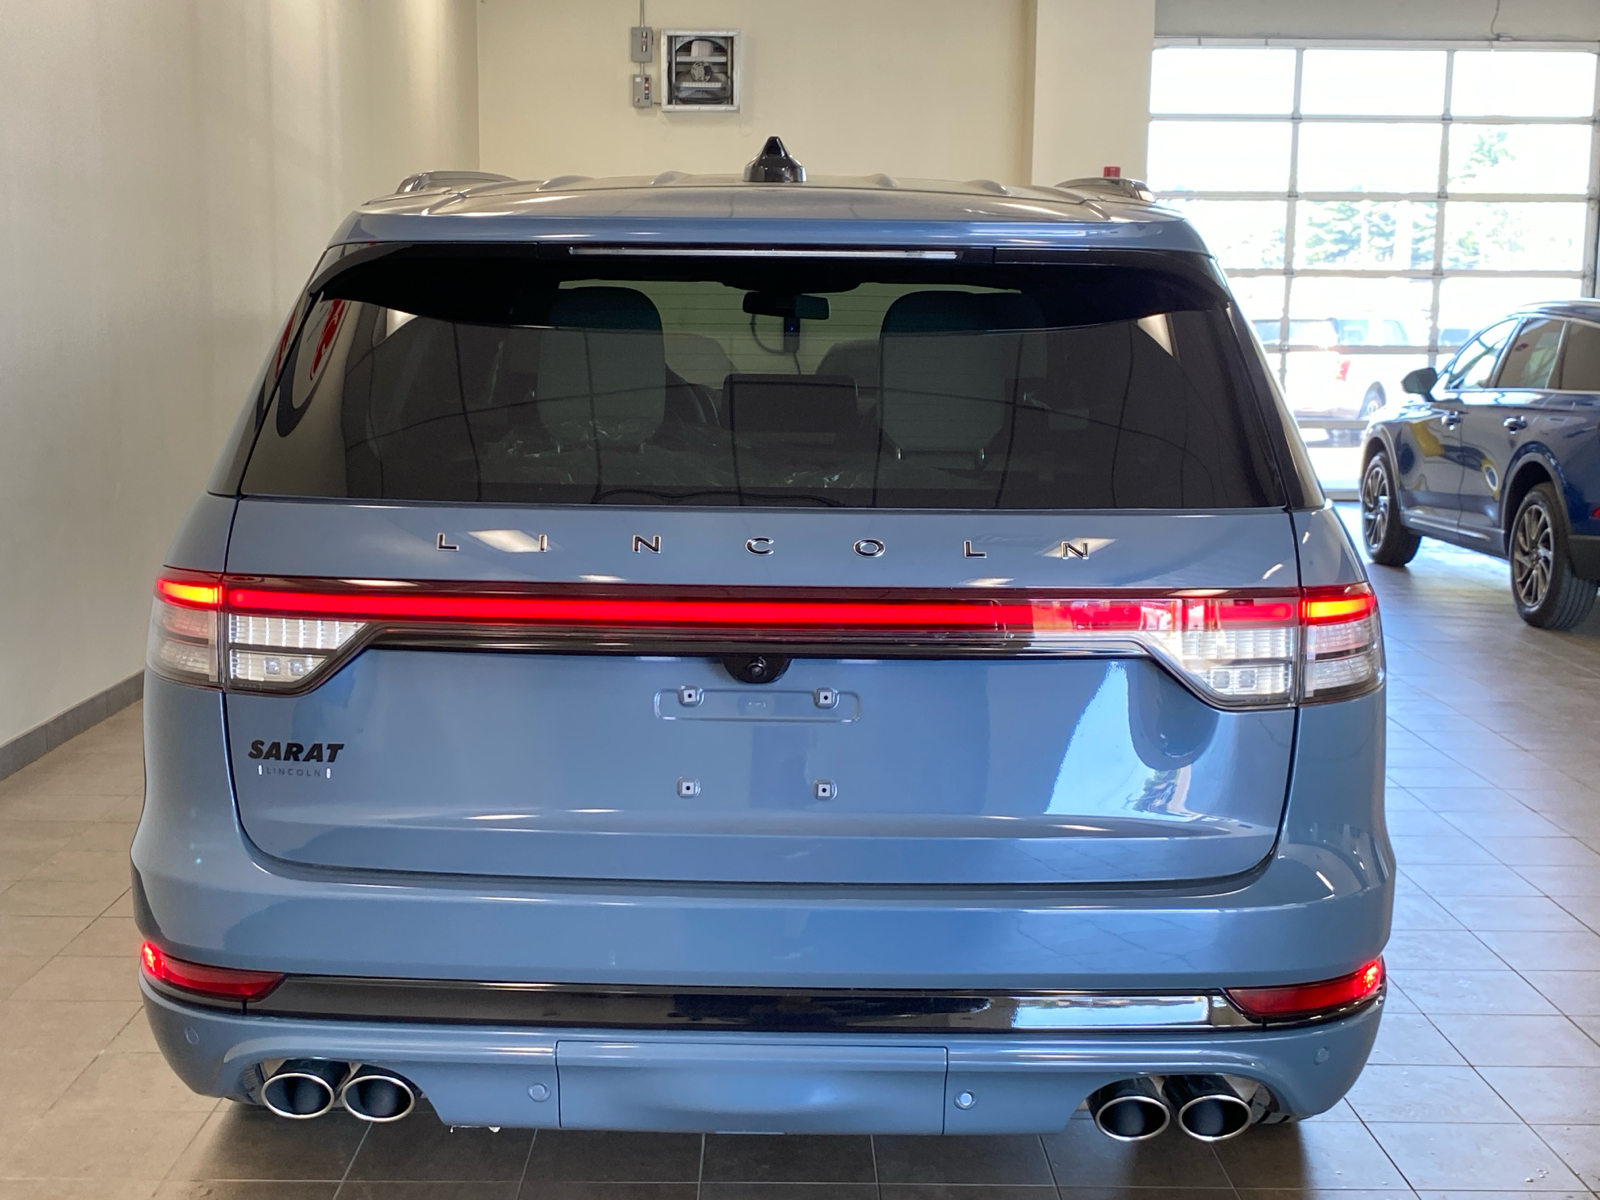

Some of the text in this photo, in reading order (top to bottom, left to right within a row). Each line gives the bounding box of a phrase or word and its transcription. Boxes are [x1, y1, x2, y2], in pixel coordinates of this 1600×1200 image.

[437, 534, 1090, 560] LINCOLN
[247, 740, 345, 763] SARAT
[266, 767, 321, 777] LINCOLN
